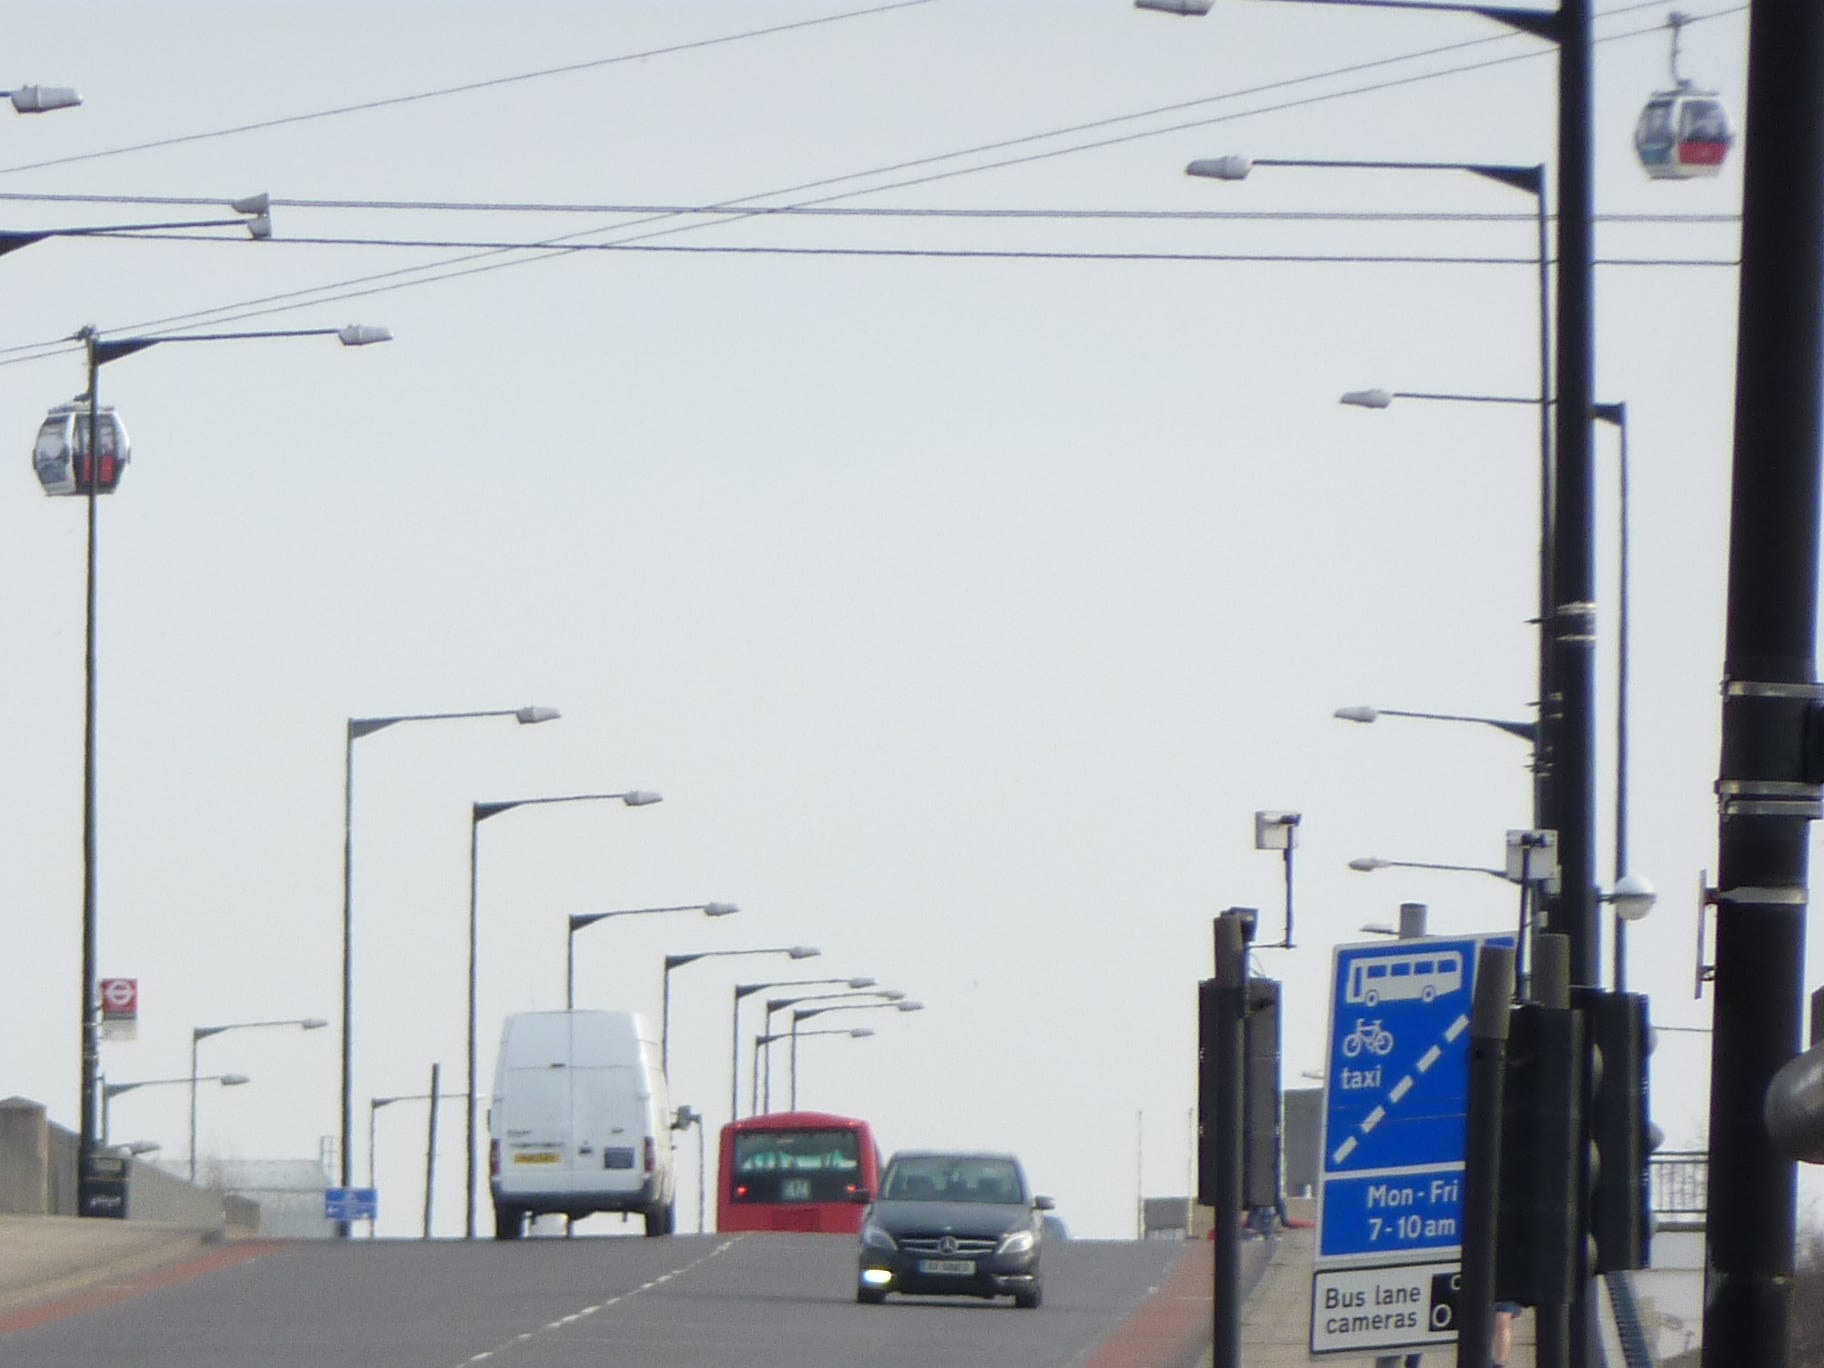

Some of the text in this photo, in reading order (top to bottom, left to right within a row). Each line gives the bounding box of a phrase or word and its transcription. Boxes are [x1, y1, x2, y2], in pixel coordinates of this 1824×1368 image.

[1341, 1065, 1380, 1089] taxi
[1368, 1184, 1414, 1209] Mon
[1430, 1179, 1459, 1203] Fri
[1325, 1284, 1421, 1309] Bus lane
[1327, 1311, 1417, 1334] cameras
